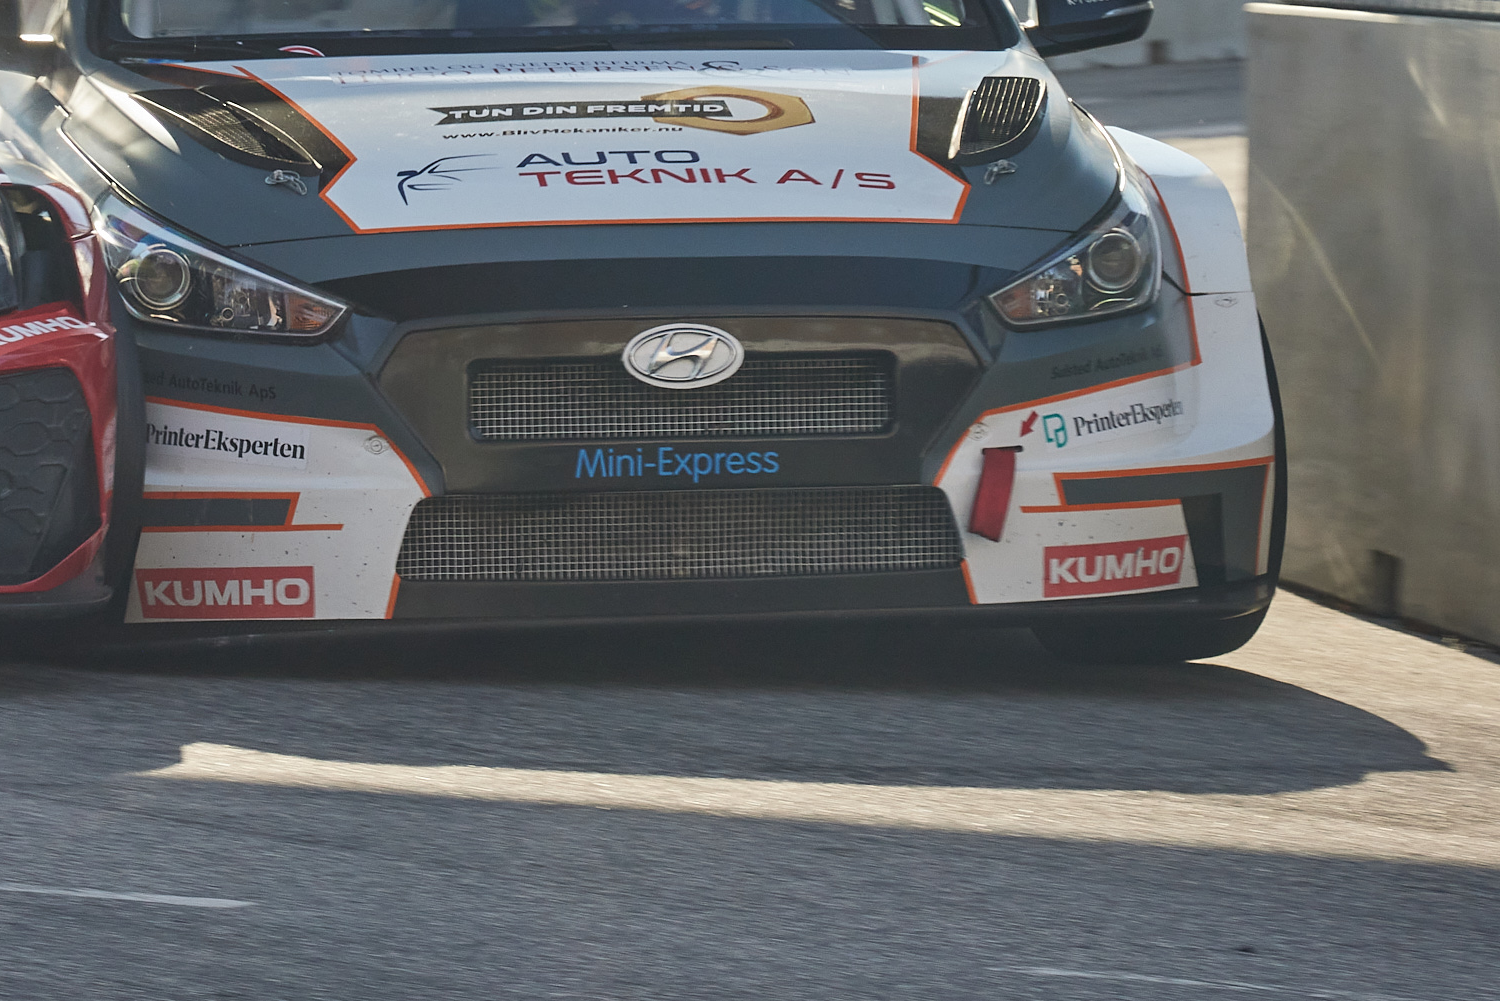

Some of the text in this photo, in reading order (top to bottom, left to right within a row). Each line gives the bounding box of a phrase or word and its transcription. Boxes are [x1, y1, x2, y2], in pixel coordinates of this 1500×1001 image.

[449, 103, 725, 119] TUN DIN FREMTID
[516, 150, 700, 168] AUTO
[518, 168, 896, 190] TEKNIK A/S
[168, 373, 243, 396] AutoTeknik
[248, 384, 277, 402] ApS
[146, 423, 306, 460] PrinterEksperten
[575, 446, 780, 483] Mini-Express
[1049, 547, 1181, 585] KUMHO
[143, 578, 310, 607] KUMHO
